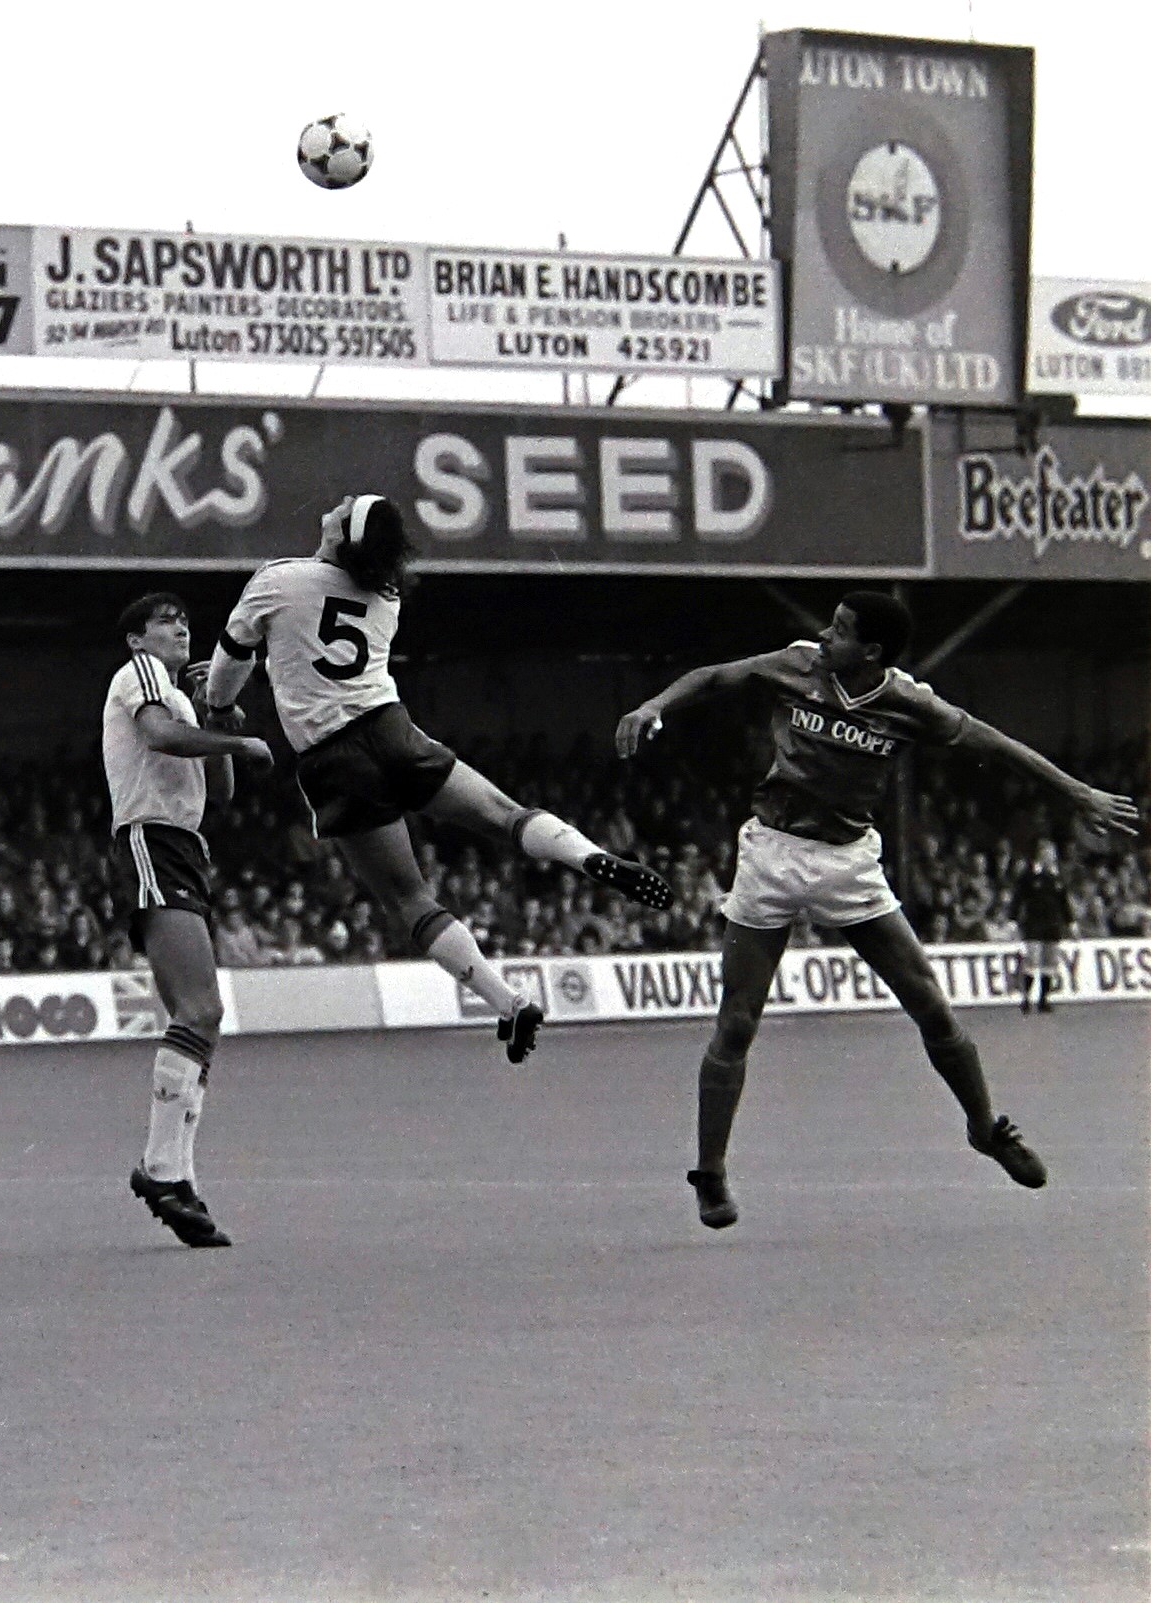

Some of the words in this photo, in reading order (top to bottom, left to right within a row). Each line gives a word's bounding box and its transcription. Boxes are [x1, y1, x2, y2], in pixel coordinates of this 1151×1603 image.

[898, 55, 990, 98] TOWN
[46, 235, 85, 284] J.
[94, 236, 350, 294] SAPSWORTH
[433, 259, 528, 299] BRIAN
[562, 265, 767, 308] HANDSCOMBE
[46, 288, 149, 313] GLAZIERS
[163, 292, 262, 317] PAINTERS
[447, 302, 495, 325] LIFE
[528, 306, 622, 330] PENSION
[629, 310, 722, 333] BROKERS
[1070, 299, 1147, 341] Ford
[171, 319, 241, 354] Luton
[496, 331, 589, 358] LUTON
[616, 335, 712, 363] 425921
[835, 306, 918, 345] Home
[925, 309, 958, 348] of
[794, 346, 858, 386] SKF
[934, 352, 1001, 392] LTD
[1035, 353, 1104, 380] LUTON
[414, 432, 771, 540] SEED
[958, 446, 1149, 557] Beefeater
[312, 596, 369, 680] 5
[790, 706, 826, 734] IND
[803, 956, 891, 1002] OPEL
